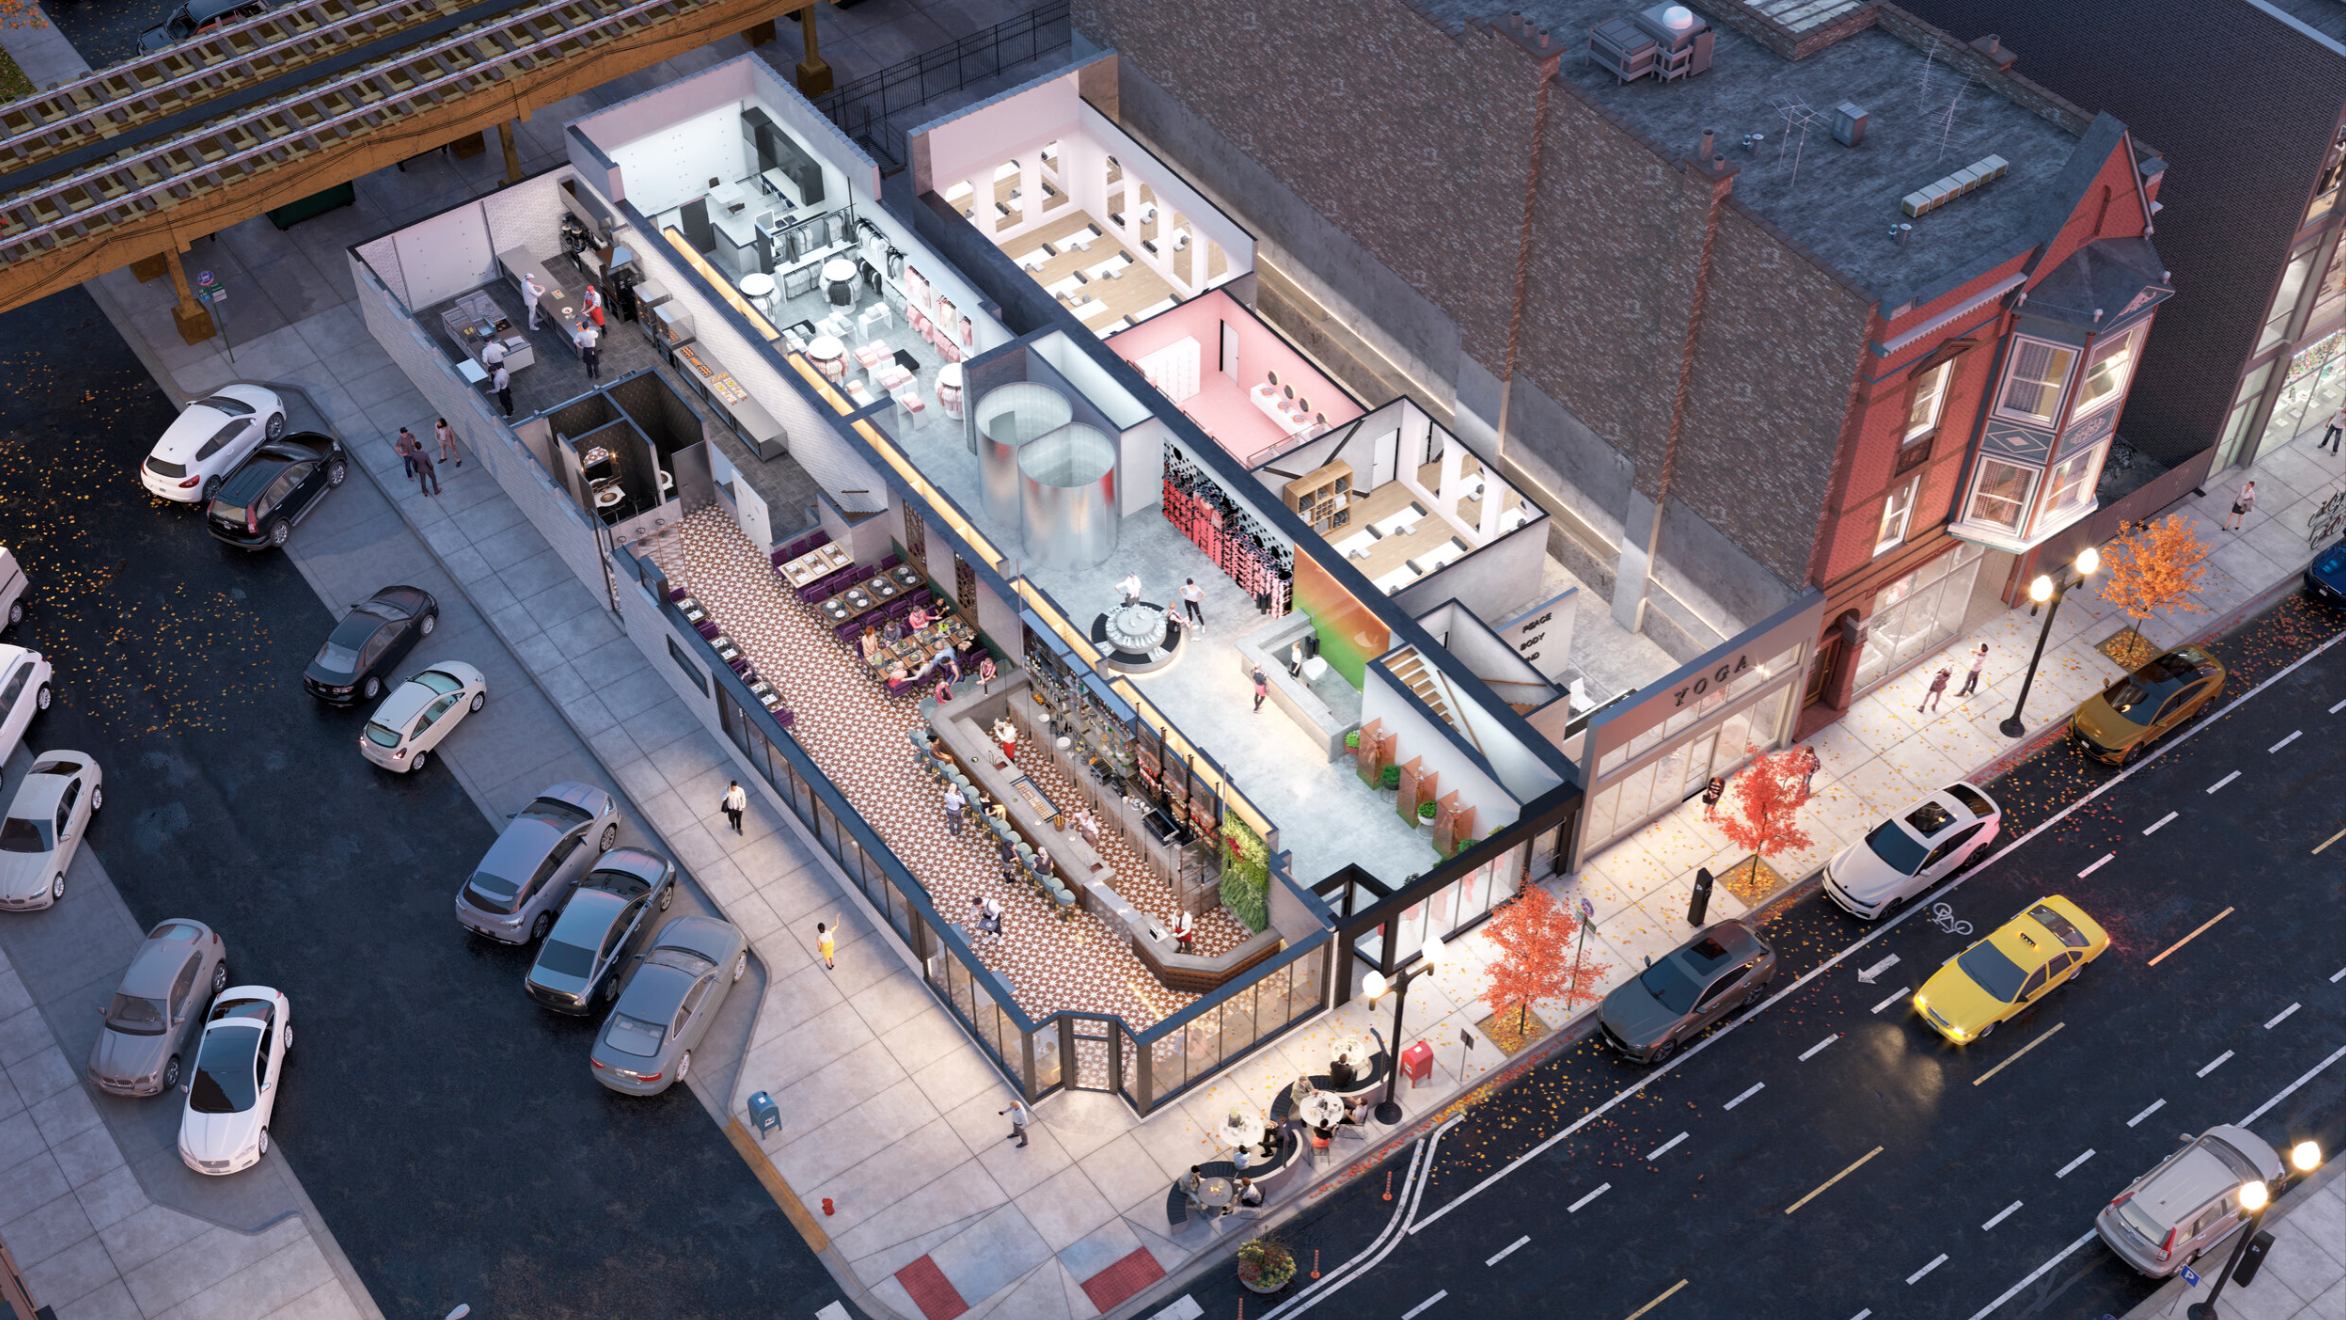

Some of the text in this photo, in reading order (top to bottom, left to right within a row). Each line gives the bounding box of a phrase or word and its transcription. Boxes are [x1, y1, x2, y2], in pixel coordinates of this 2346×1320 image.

[1522, 612, 1552, 634] PEACE
[1520, 632, 1545, 651] BODY
[1673, 655, 1749, 707] YOGA
[2251, 1245, 2261, 1253] P
[2184, 1270, 2195, 1280] P
